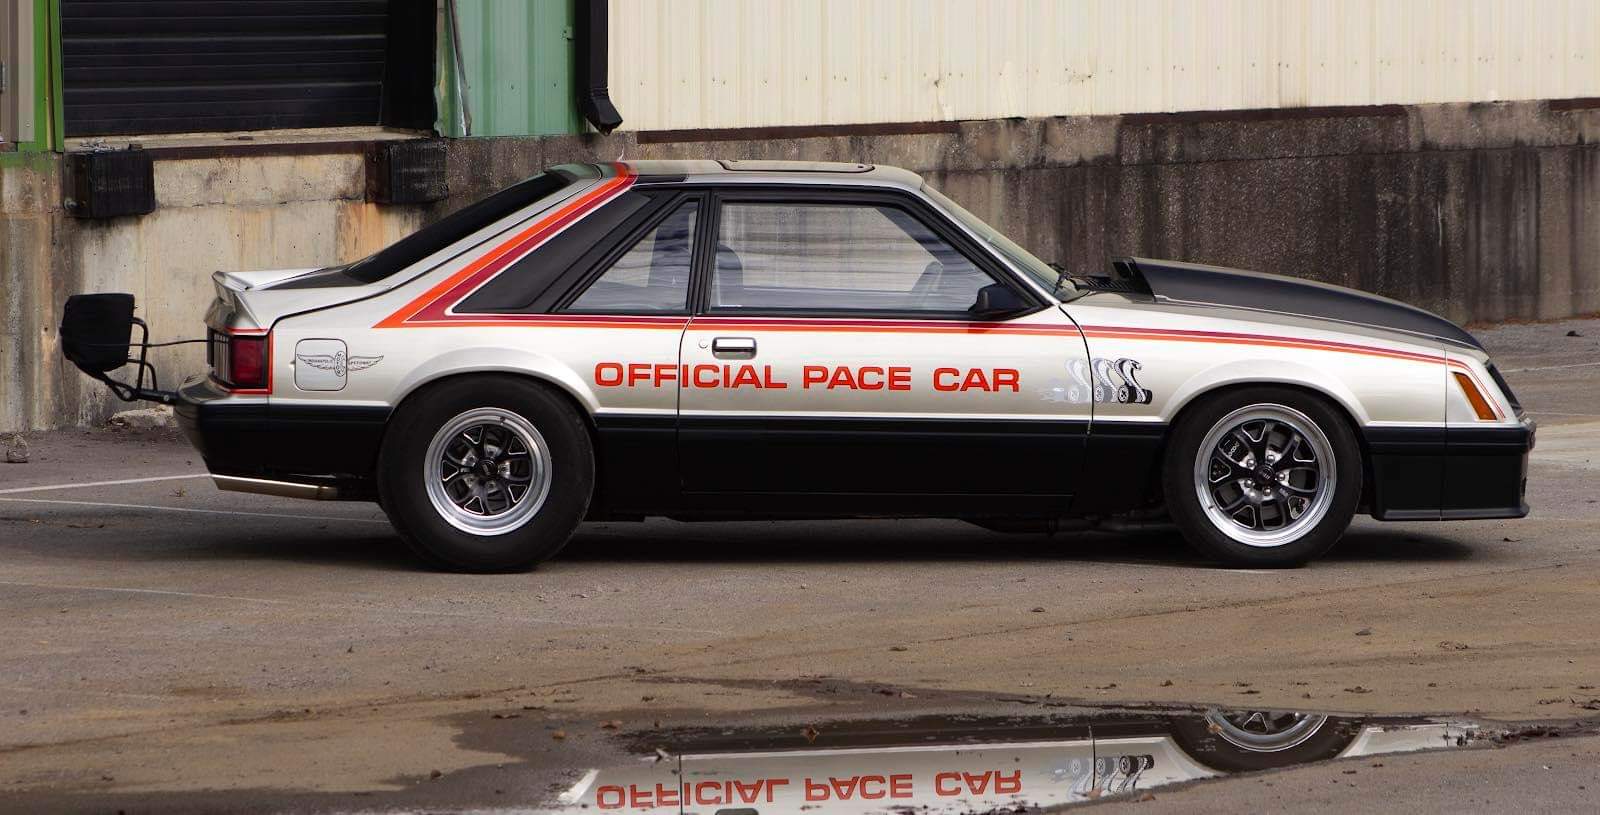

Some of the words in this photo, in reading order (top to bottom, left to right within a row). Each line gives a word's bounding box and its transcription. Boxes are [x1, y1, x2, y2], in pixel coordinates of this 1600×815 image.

[594, 362, 788, 389] OFFICIAL
[802, 365, 912, 391] PACE
[932, 367, 1020, 393] CAR
